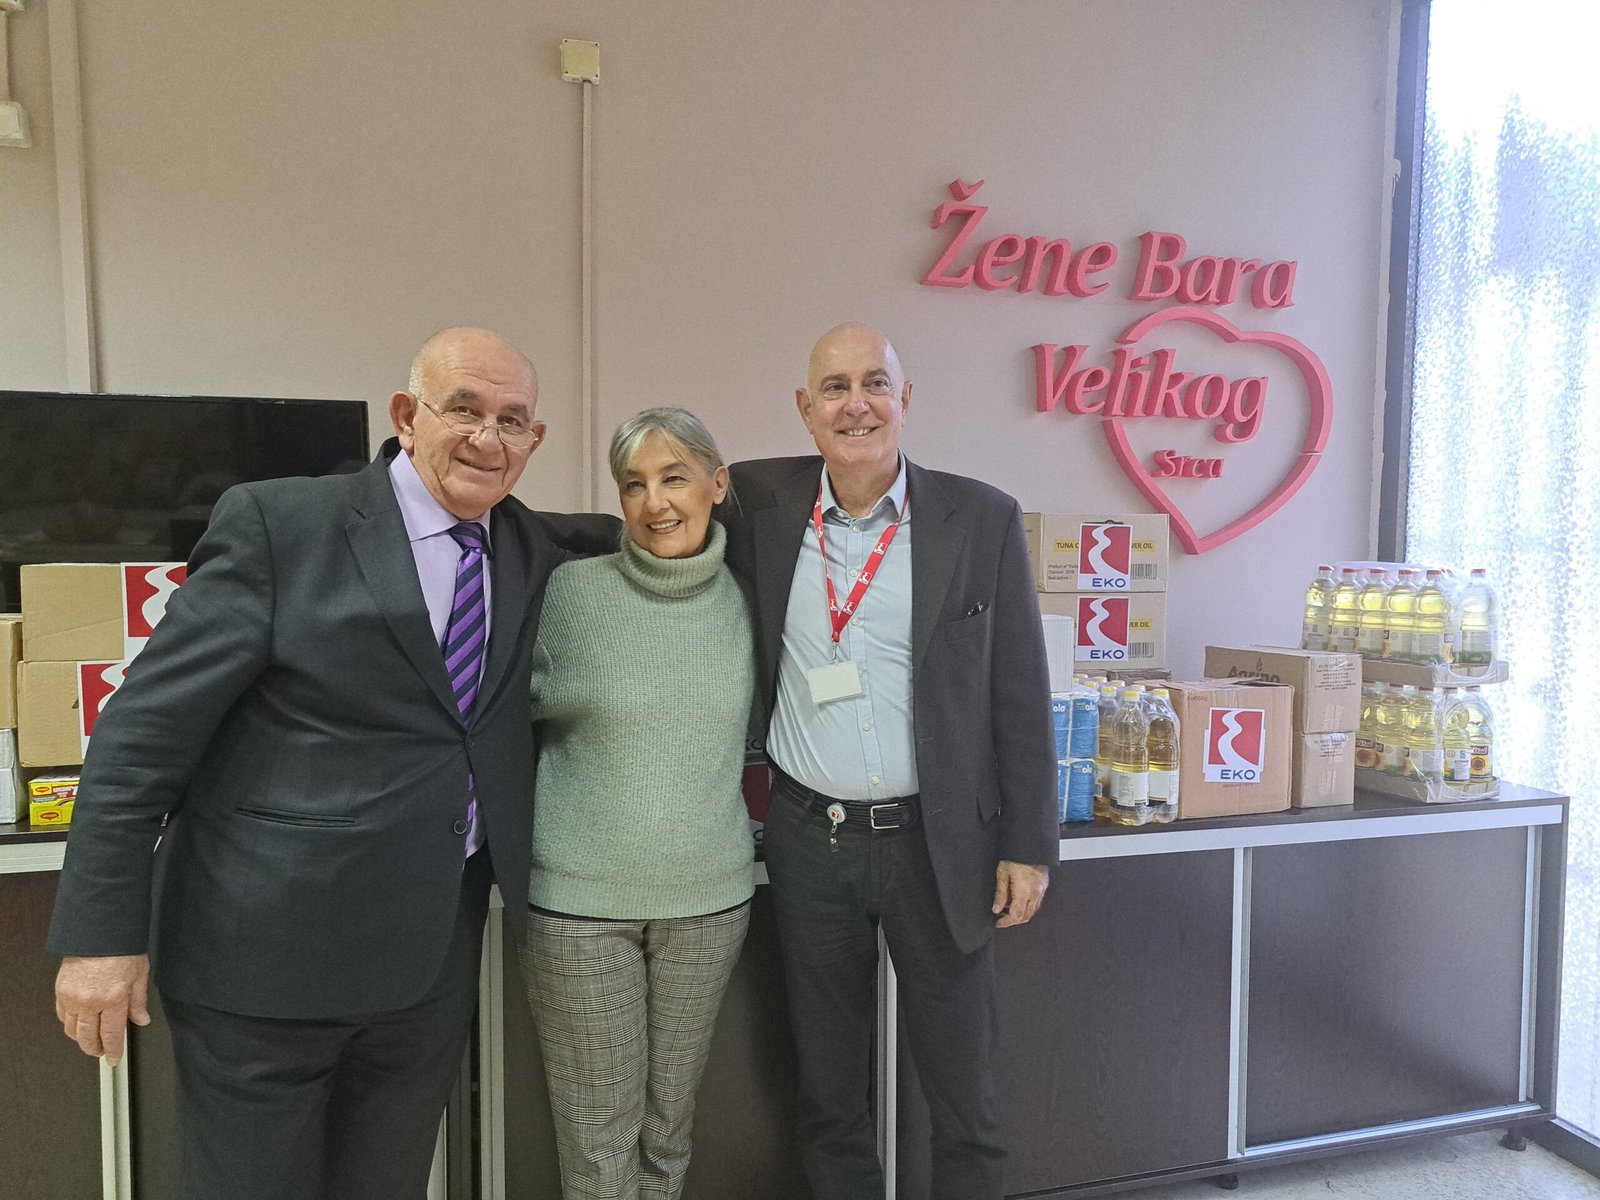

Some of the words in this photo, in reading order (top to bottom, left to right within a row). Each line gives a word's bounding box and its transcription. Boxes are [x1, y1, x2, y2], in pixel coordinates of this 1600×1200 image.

[920, 177, 1118, 297] Žene
[1128, 231, 1299, 308] Bara
[1032, 342, 1269, 443] Velikog
[1151, 449, 1224, 479] Srca
[1092, 578, 1126, 588] EKO
[1090, 649, 1125, 660] EKO
[1220, 769, 1256, 781] EKO
